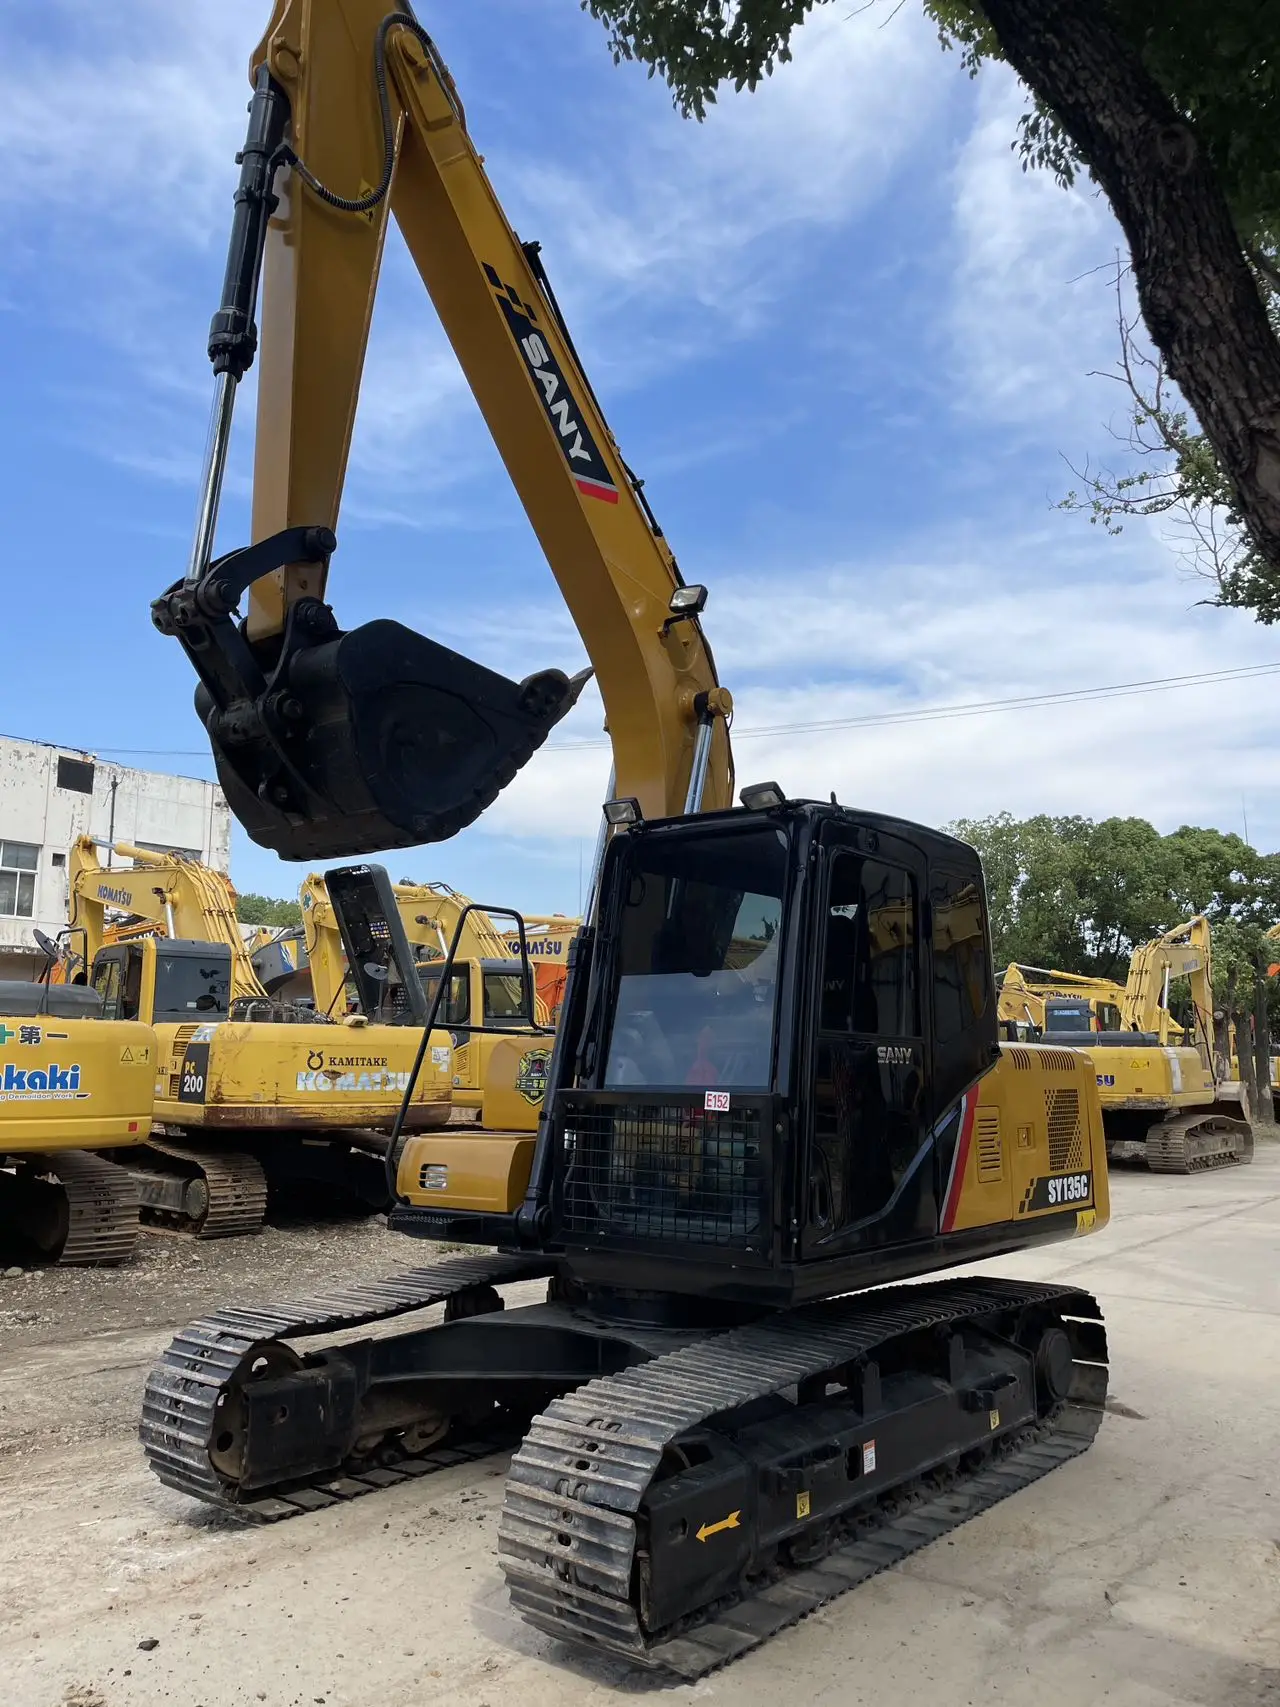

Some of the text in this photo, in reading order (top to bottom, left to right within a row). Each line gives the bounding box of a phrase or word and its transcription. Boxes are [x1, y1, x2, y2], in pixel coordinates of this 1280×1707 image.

[521, 333, 592, 462] SANY
[97, 884, 133, 906] KOMATSU
[20, 1025, 68, 1044] 第一
[328, 1056, 388, 1067] KAMITAKE
[877, 1046, 912, 1064] SANY
[184, 1061, 196, 1074] PC
[0, 1064, 80, 1090] kaki
[183, 1075, 203, 1093] 200
[706, 1093, 729, 1109] E152
[1048, 1174, 1088, 1204] SY135C
